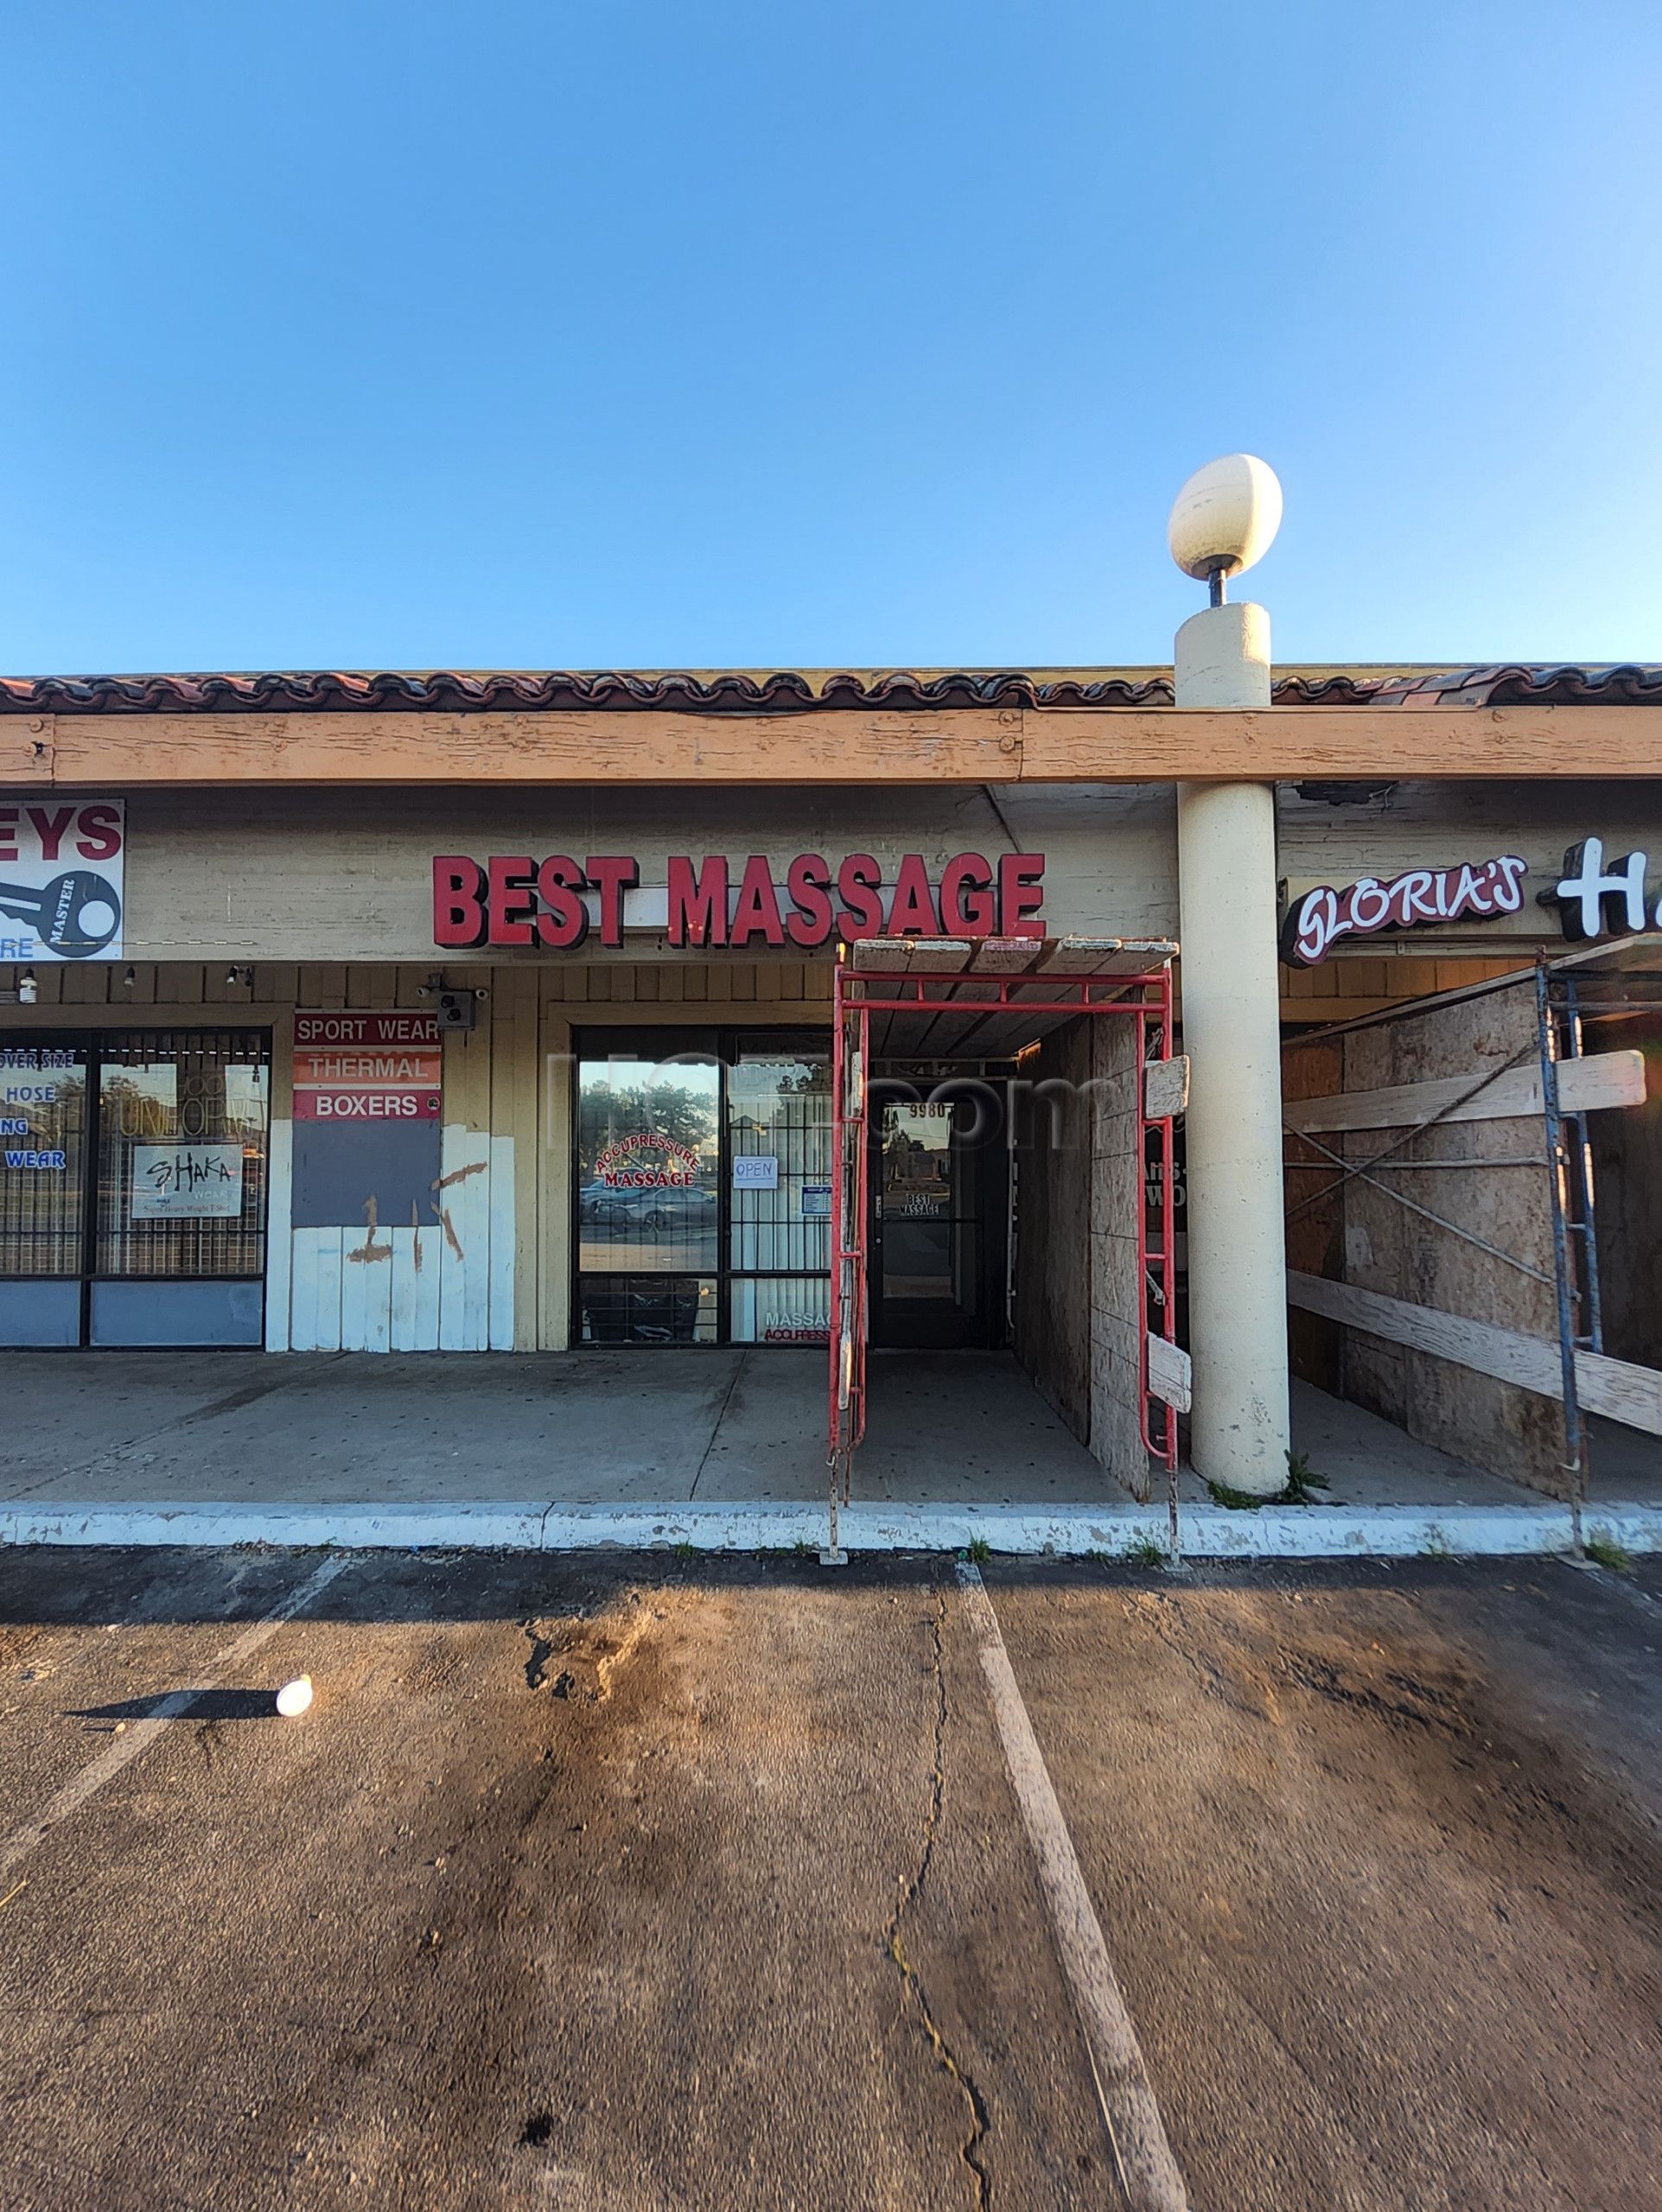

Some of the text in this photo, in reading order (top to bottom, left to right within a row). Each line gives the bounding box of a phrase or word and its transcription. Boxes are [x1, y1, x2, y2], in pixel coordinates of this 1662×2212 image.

[1557, 836, 1662, 938] H
[432, 852, 1048, 948] BEST MASSAGE
[1298, 855, 1526, 959] GLORIA'S
[49, 879, 75, 944] MASTER
[297, 1020, 439, 1040] SPORT WEAR
[41, 1053, 73, 1069] SIZE
[308, 1058, 429, 1078] THERMAL
[6, 1086, 55, 1103] HOSE
[316, 1095, 418, 1116] BOXERS
[909, 1103, 946, 1118] 9980
[5, 1151, 67, 1169] WEAR
[595, 1133, 701, 1173] ACCUPRESSURE
[146, 1152, 232, 1192] SHAKA
[735, 1162, 773, 1177] OPEN
[604, 1172, 695, 1188] MASSAGE
[907, 1193, 930, 1205] BEST
[900, 1204, 939, 1216] MASSAGE
[766, 1312, 831, 1327] MASSA
